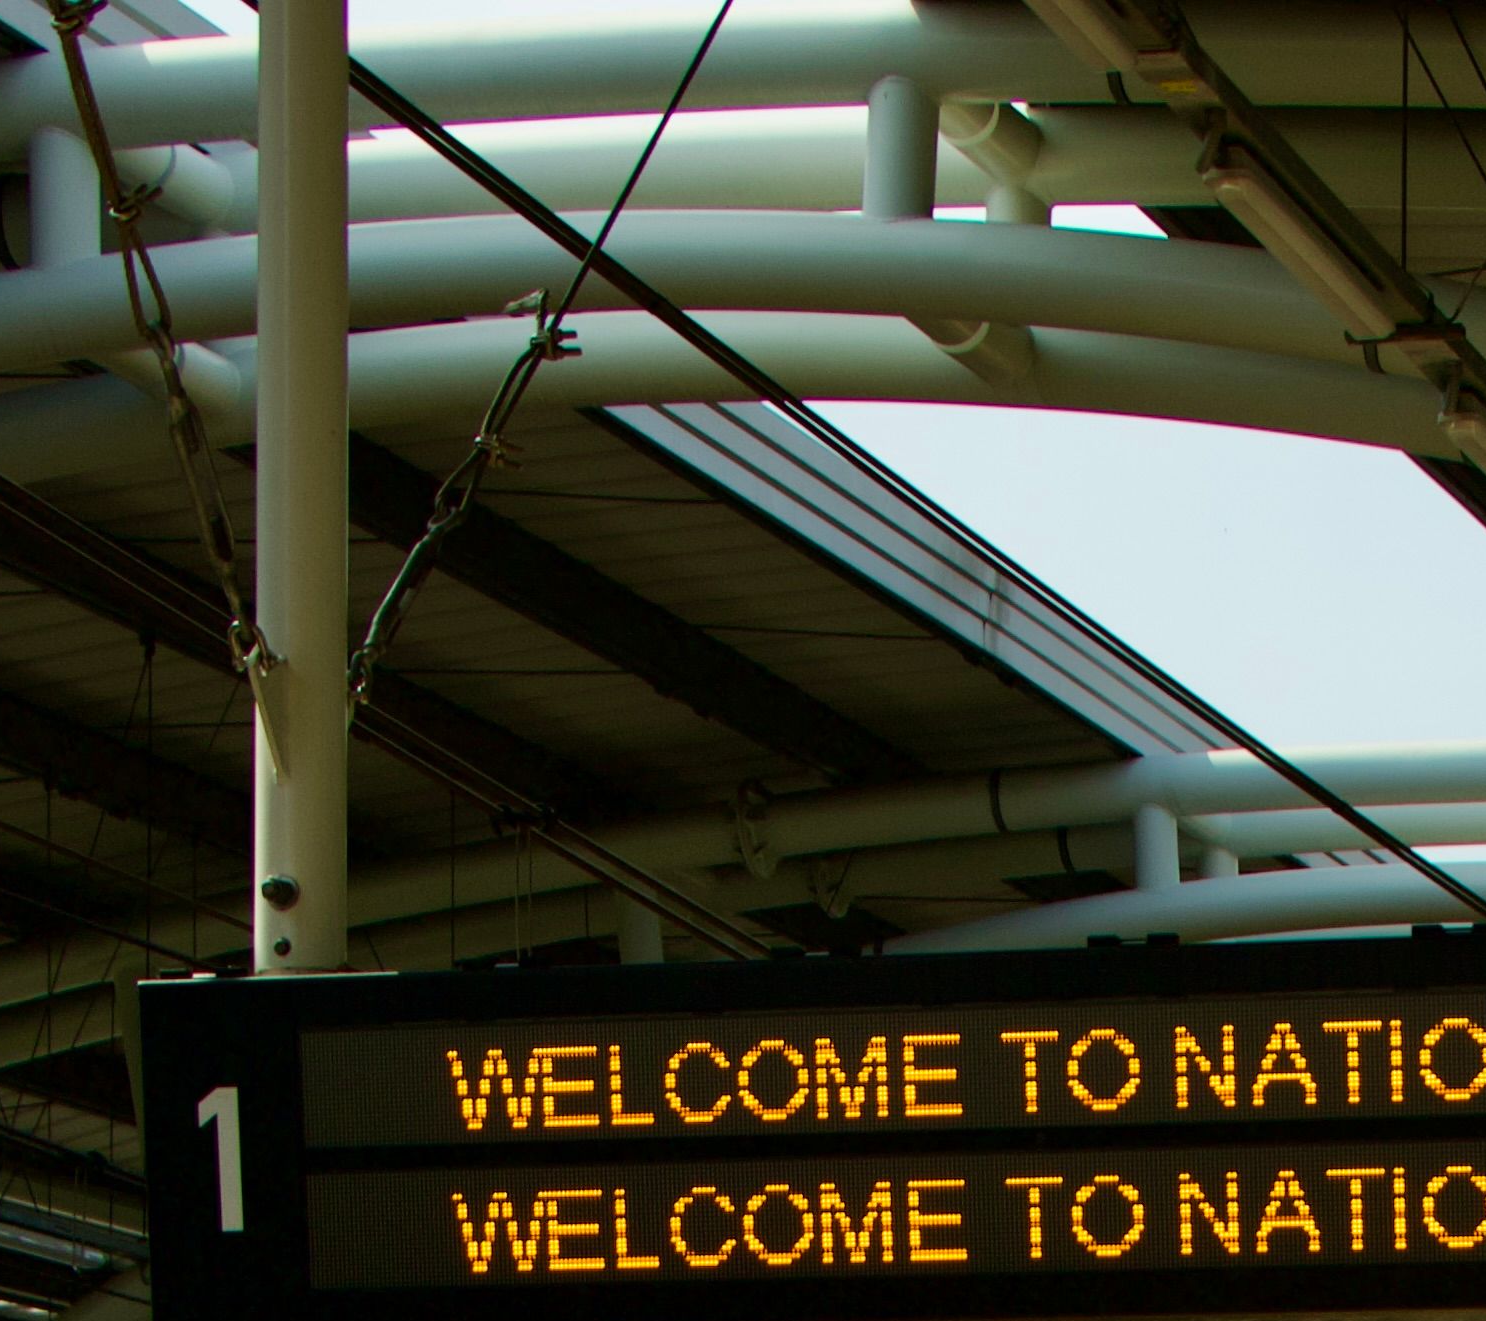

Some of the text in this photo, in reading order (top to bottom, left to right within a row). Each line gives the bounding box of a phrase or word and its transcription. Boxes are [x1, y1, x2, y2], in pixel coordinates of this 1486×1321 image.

[446, 1033, 963, 1130] WELCOME
[1000, 1027, 1141, 1115] TO
[196, 1084, 245, 1234] 1
[452, 1178, 968, 1273] WELCOME
[1004, 1173, 1145, 1260] TO
